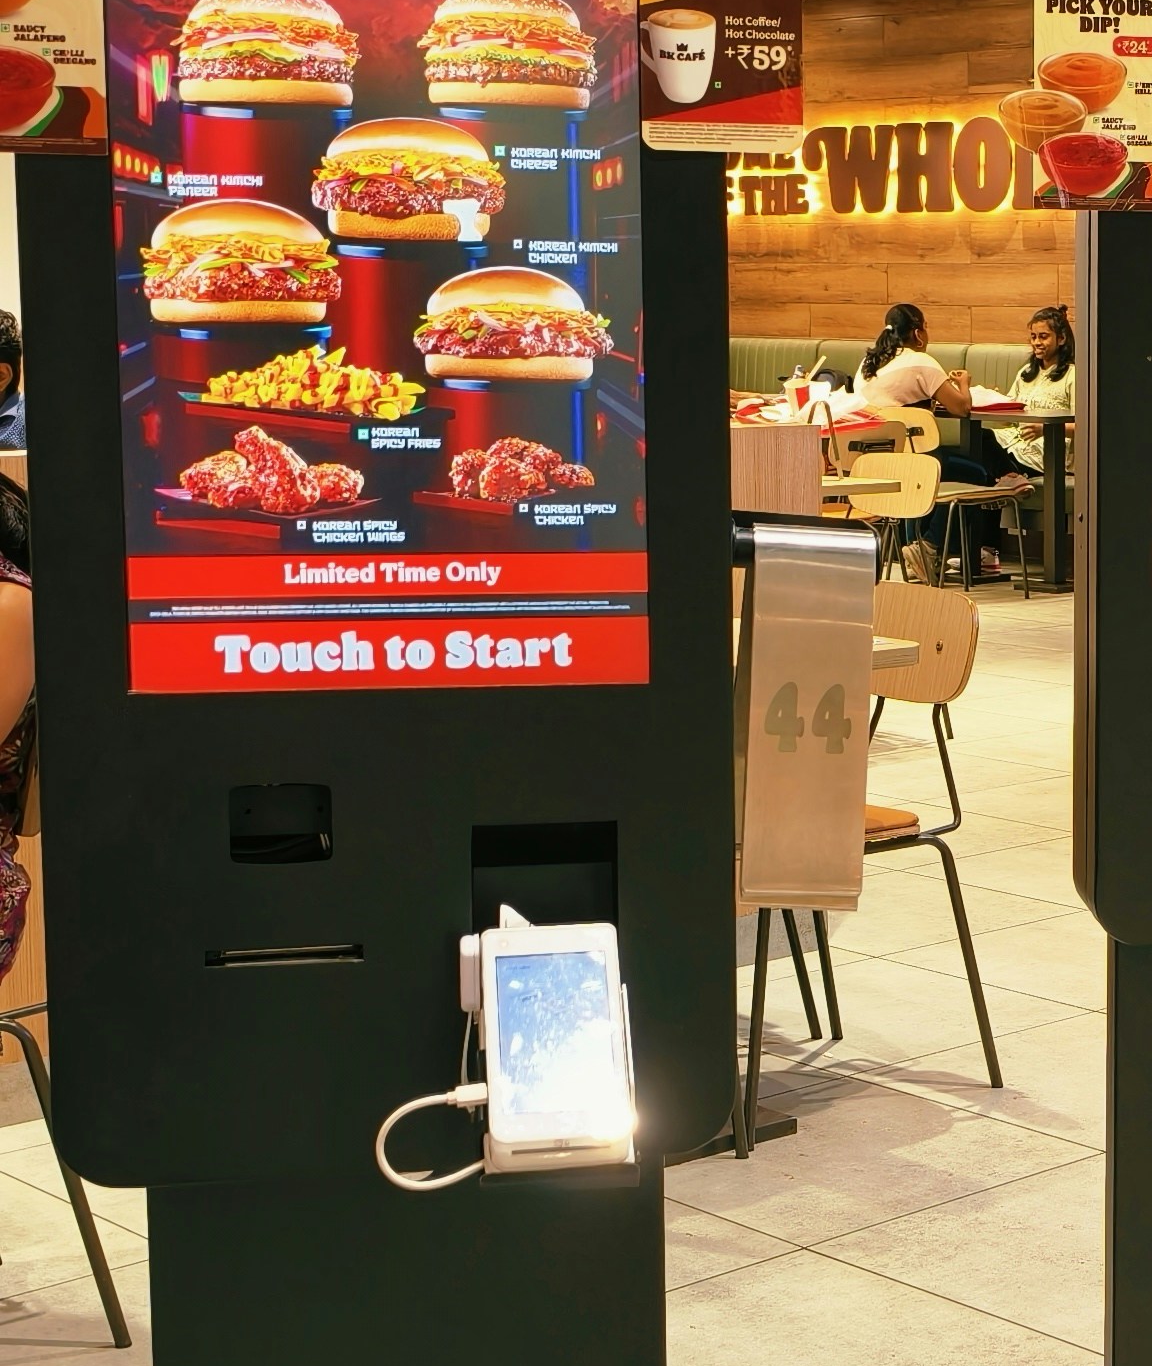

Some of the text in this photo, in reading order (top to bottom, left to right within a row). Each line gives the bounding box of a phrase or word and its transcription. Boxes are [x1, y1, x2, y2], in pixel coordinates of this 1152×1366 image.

[725, 16, 781, 28] Hot Coffee/
[1079, 16, 1121, 33] DIP!
[725, 29, 795, 41] Hot Chocolate
[660, 49, 706, 61] BK CAFÉ
[739, 174, 809, 216] THE
[283, 561, 502, 586] Limited Time Only
[214, 630, 573, 675] Touch to Start
[764, 681, 852, 754] 44
